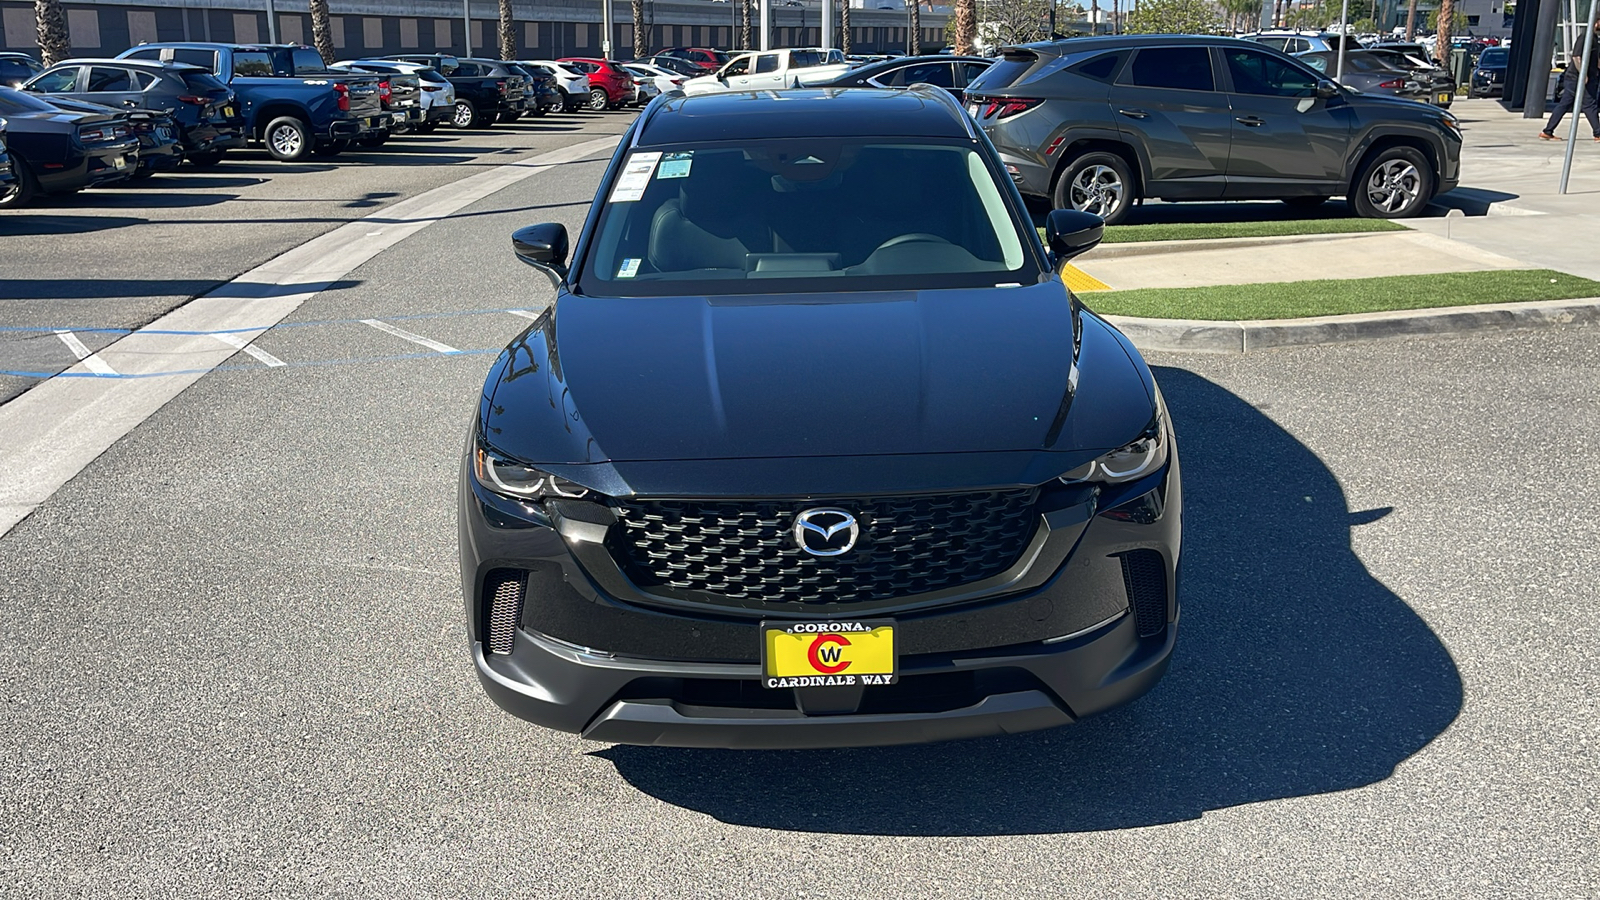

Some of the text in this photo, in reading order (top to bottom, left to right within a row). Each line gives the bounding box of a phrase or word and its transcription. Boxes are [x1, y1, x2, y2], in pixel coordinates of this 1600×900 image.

[794, 622, 864, 633] CORONA
[767, 674, 893, 688] CARDINALE WAY
